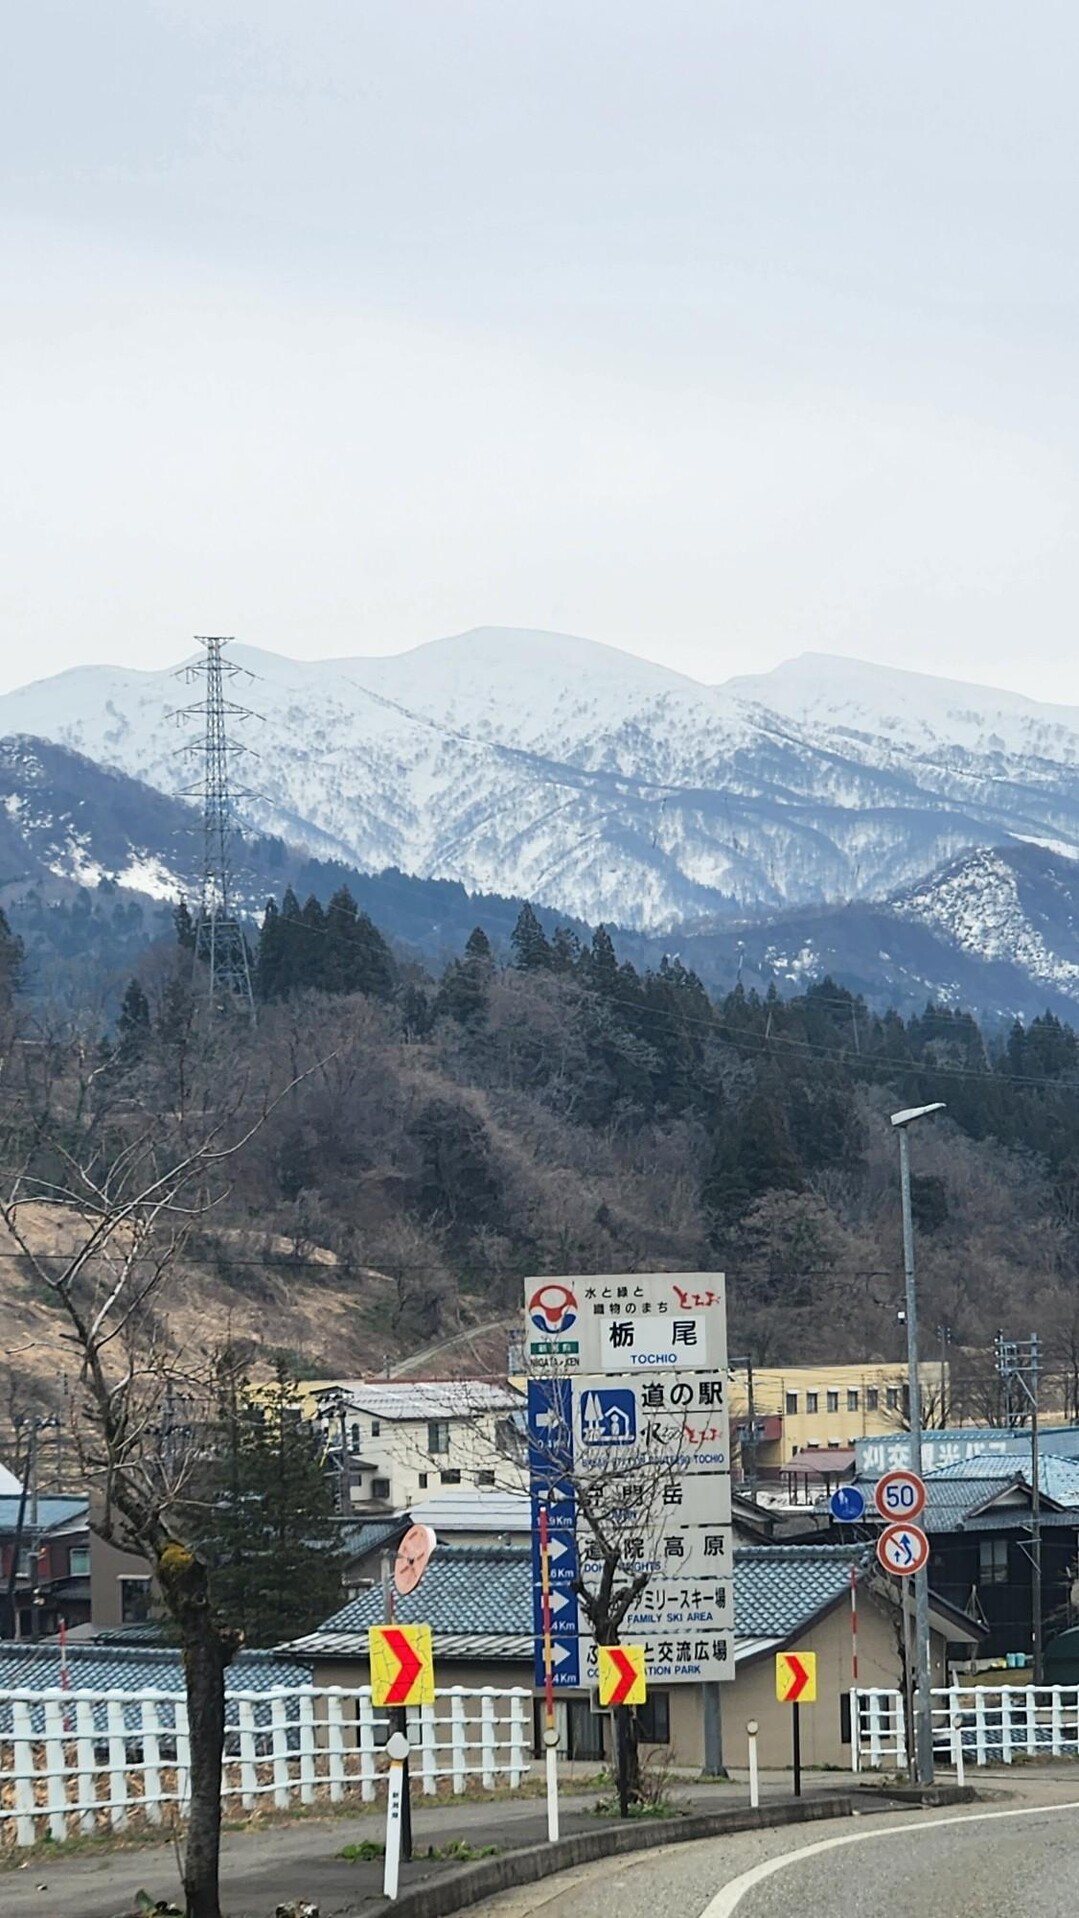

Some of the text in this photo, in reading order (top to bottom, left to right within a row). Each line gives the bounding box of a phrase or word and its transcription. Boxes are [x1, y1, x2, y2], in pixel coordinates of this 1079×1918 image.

[584, 1285, 644, 1299] 水と緑と
[593, 1301, 669, 1315] 織物のまち
[609, 1319, 698, 1348] 栃尾
[630, 1353, 678, 1364] TOCHIO
[641, 1380, 723, 1408] 道の駅
[694, 1453, 725, 1464] TOCHIO
[886, 1485, 915, 1508] 50
[627, 1611, 714, 1624] FAMILY SKI AREA
[586, 1639, 728, 1665] ふと交流広場
[674, 1664, 702, 1675] PARK
